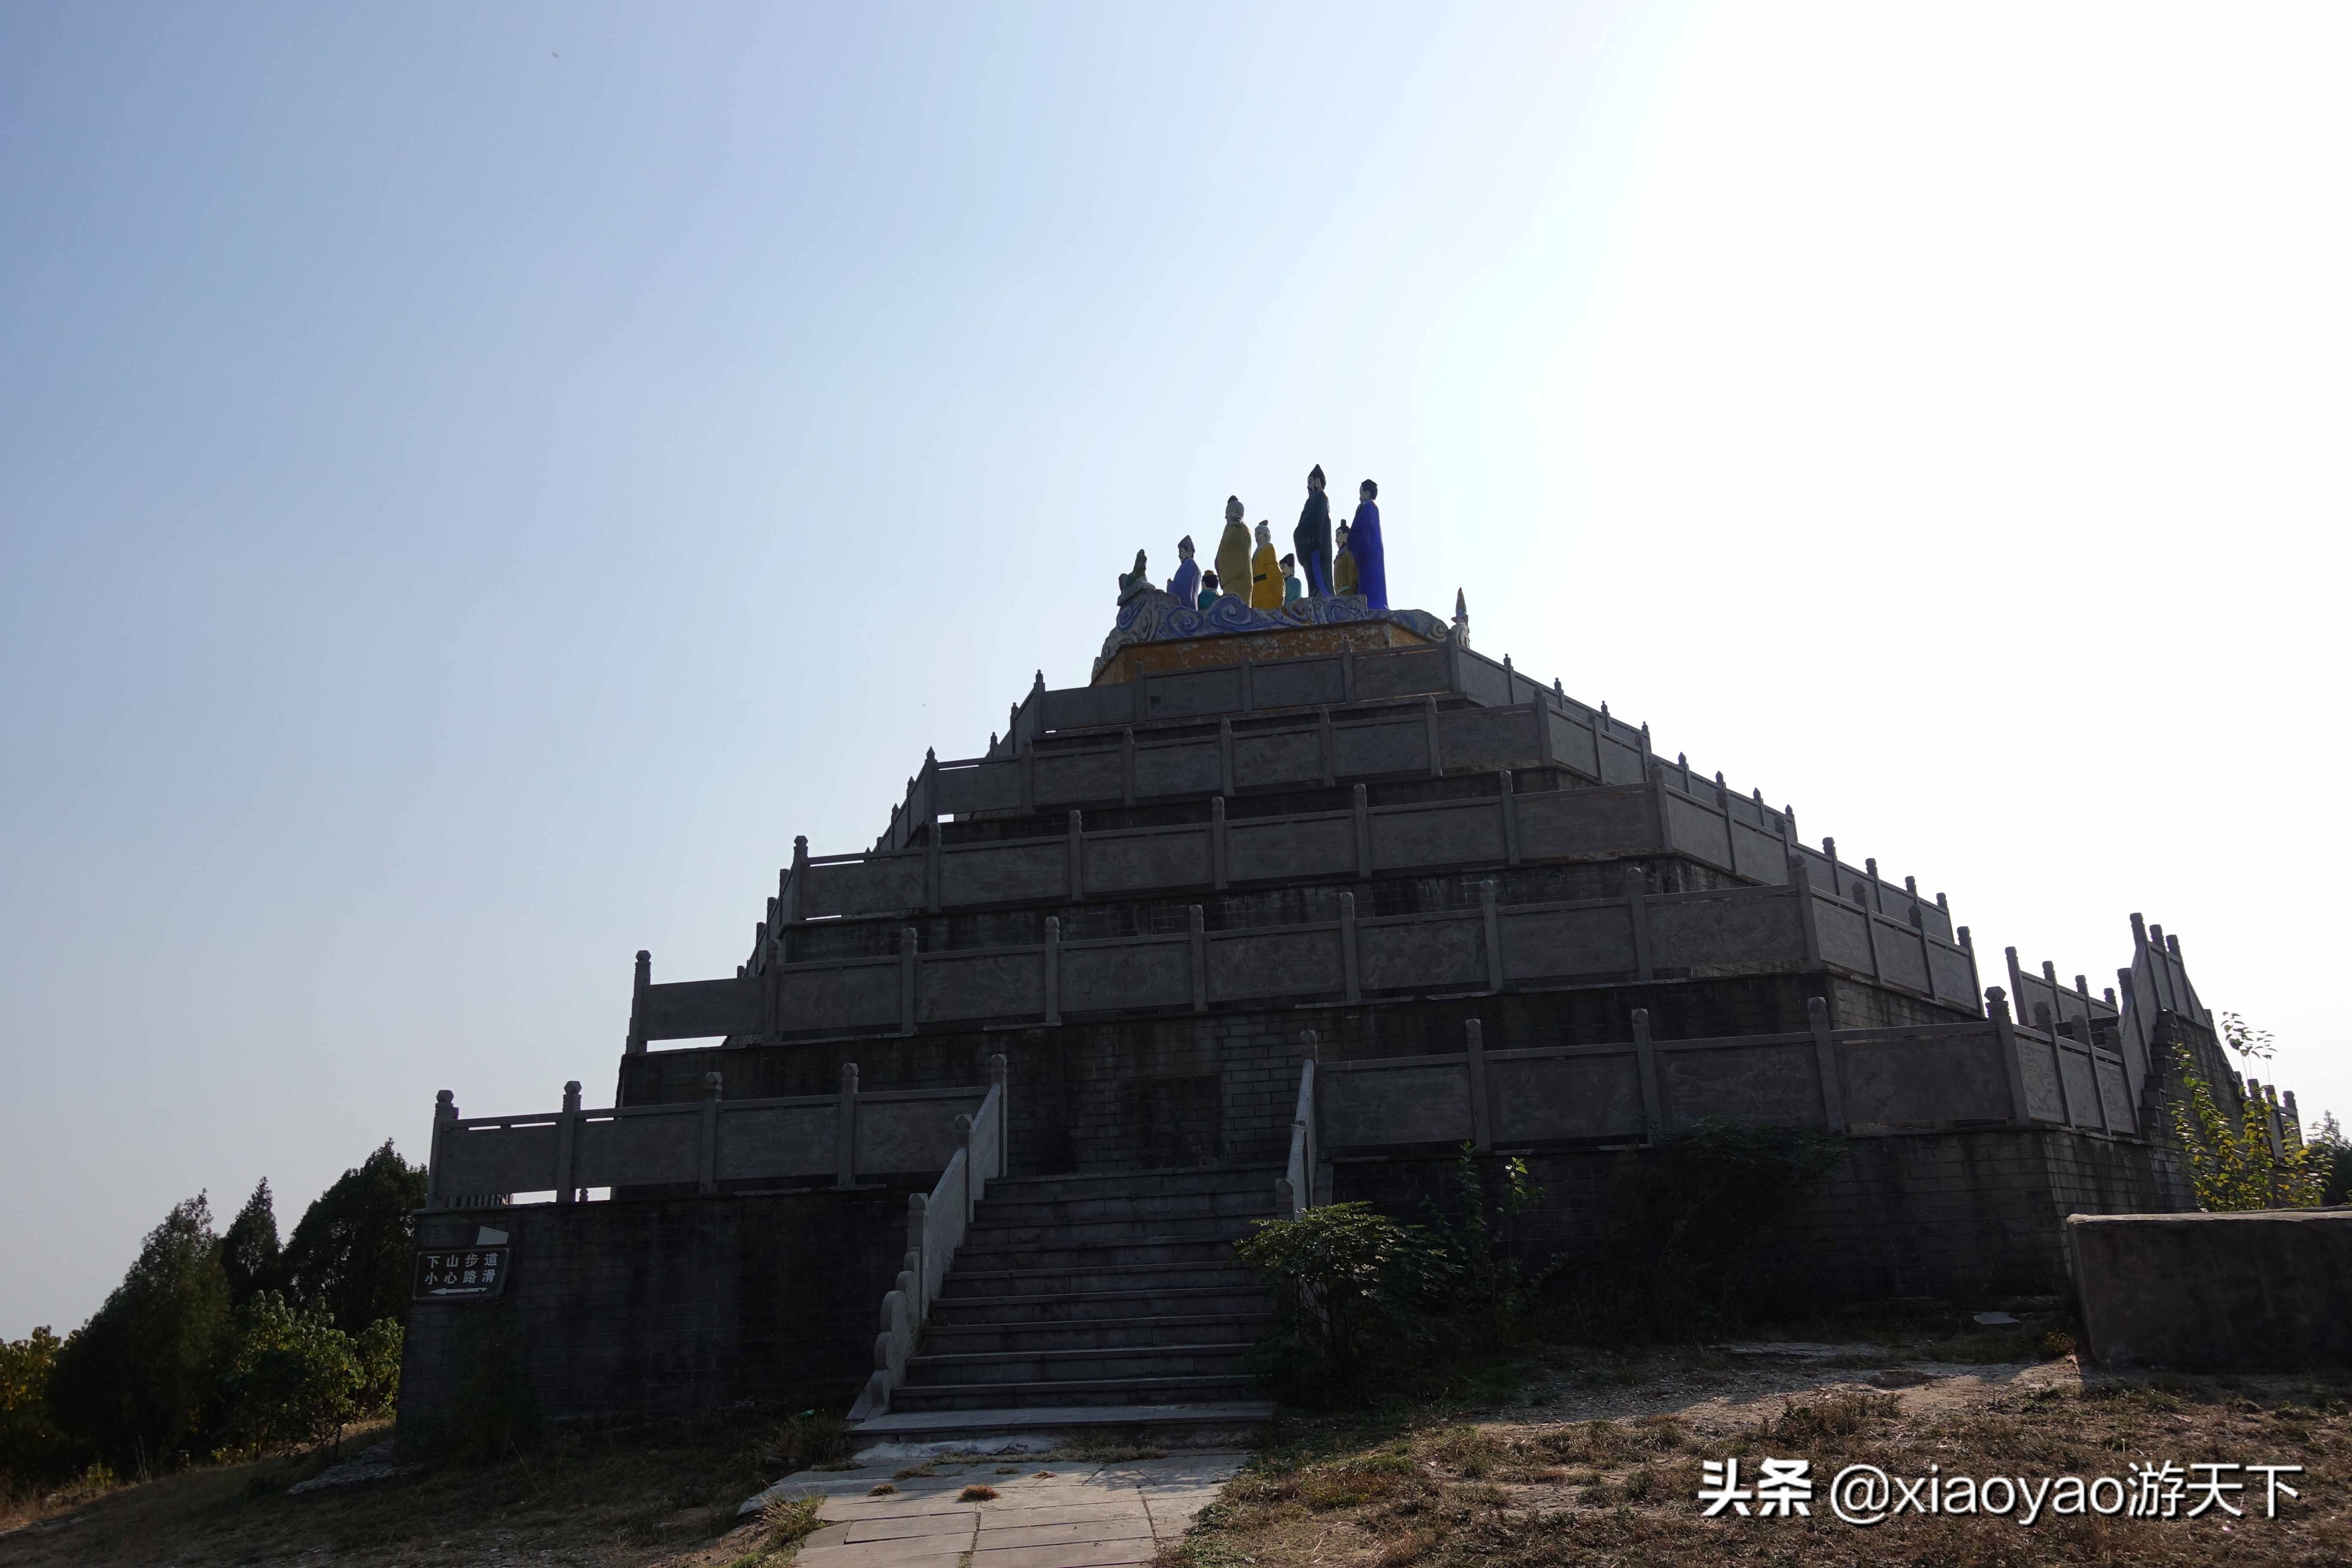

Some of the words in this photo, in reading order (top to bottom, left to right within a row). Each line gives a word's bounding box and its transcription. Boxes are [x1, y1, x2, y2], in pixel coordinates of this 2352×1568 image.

[427, 1252, 499, 1269] 下山步道
[424, 1269, 496, 1285] 小心路滑
